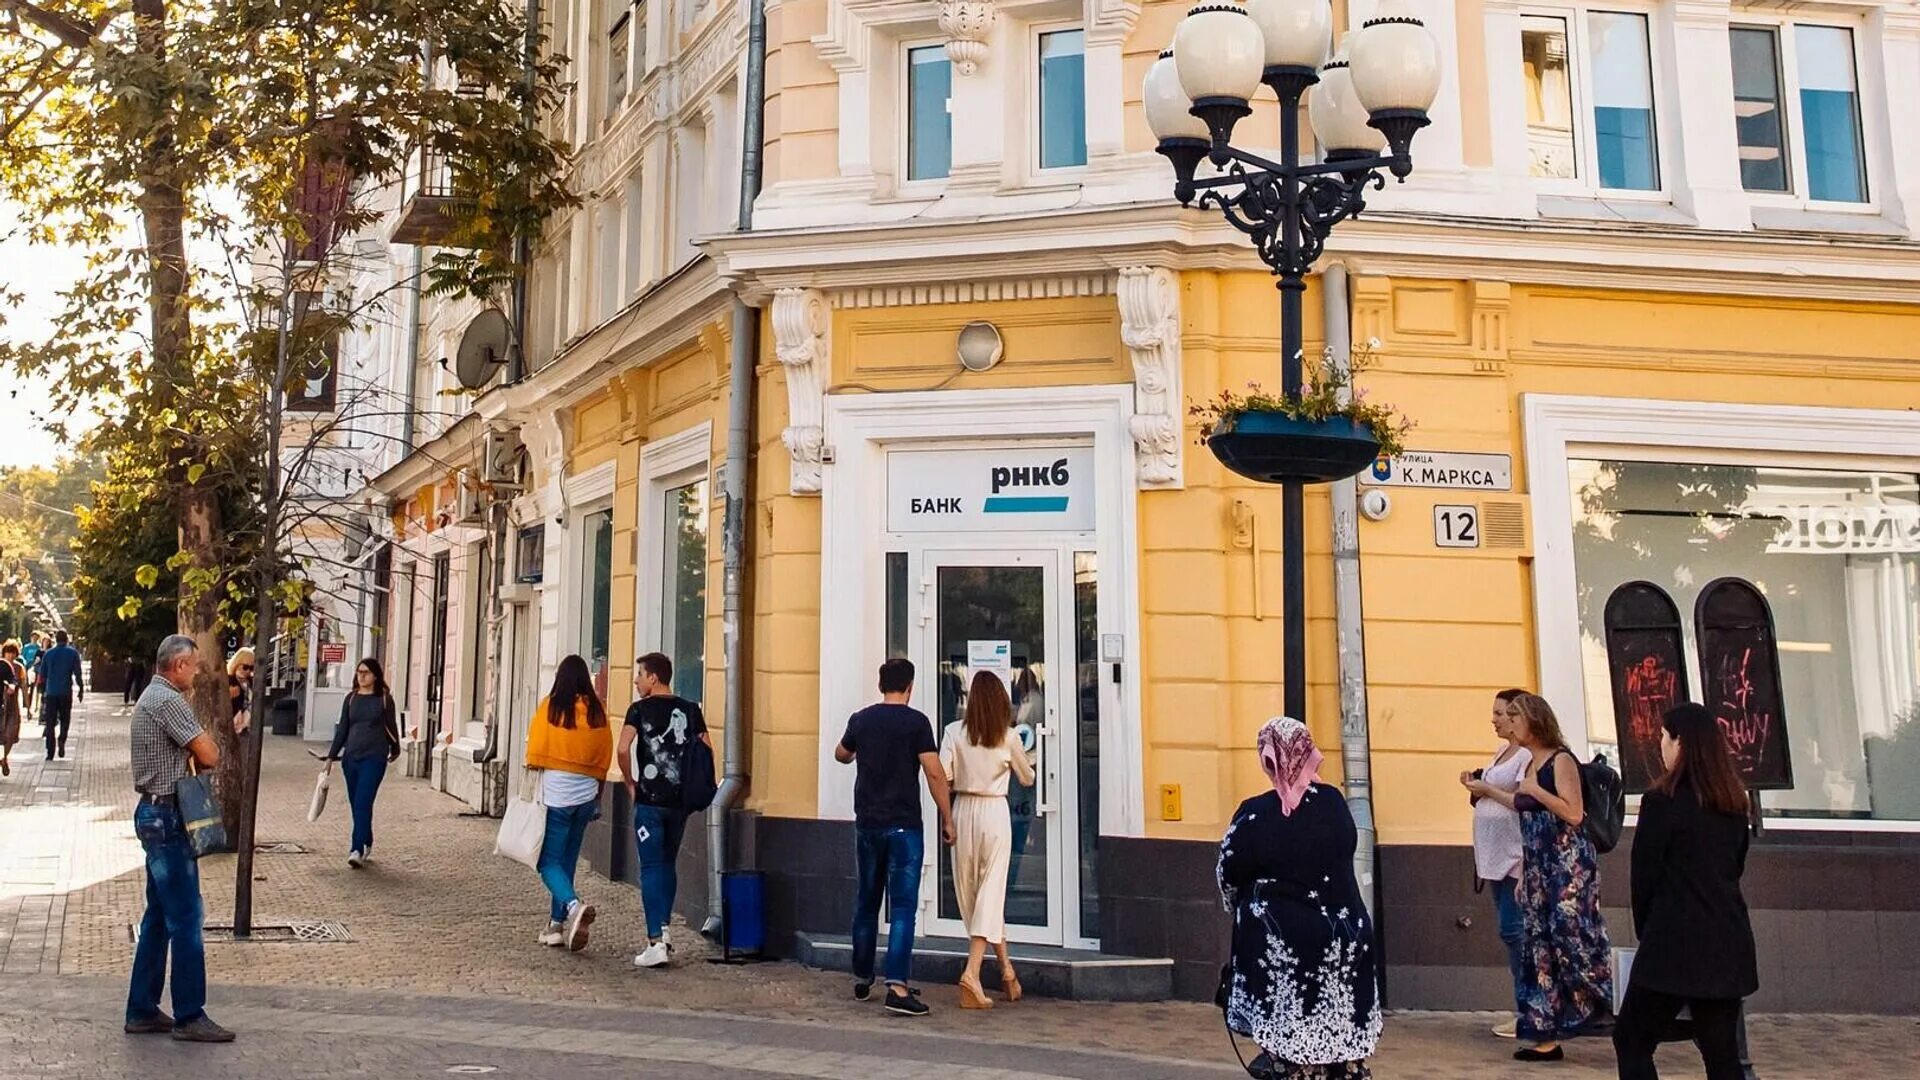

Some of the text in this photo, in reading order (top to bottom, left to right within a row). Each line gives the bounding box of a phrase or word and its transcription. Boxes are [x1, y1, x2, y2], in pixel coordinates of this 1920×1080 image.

[1402, 454, 1433, 464] УЛИЦА
[991, 458, 1069, 494] рнкб
[911, 498, 962, 513] БАНК
[1441, 512, 1475, 541] 12
